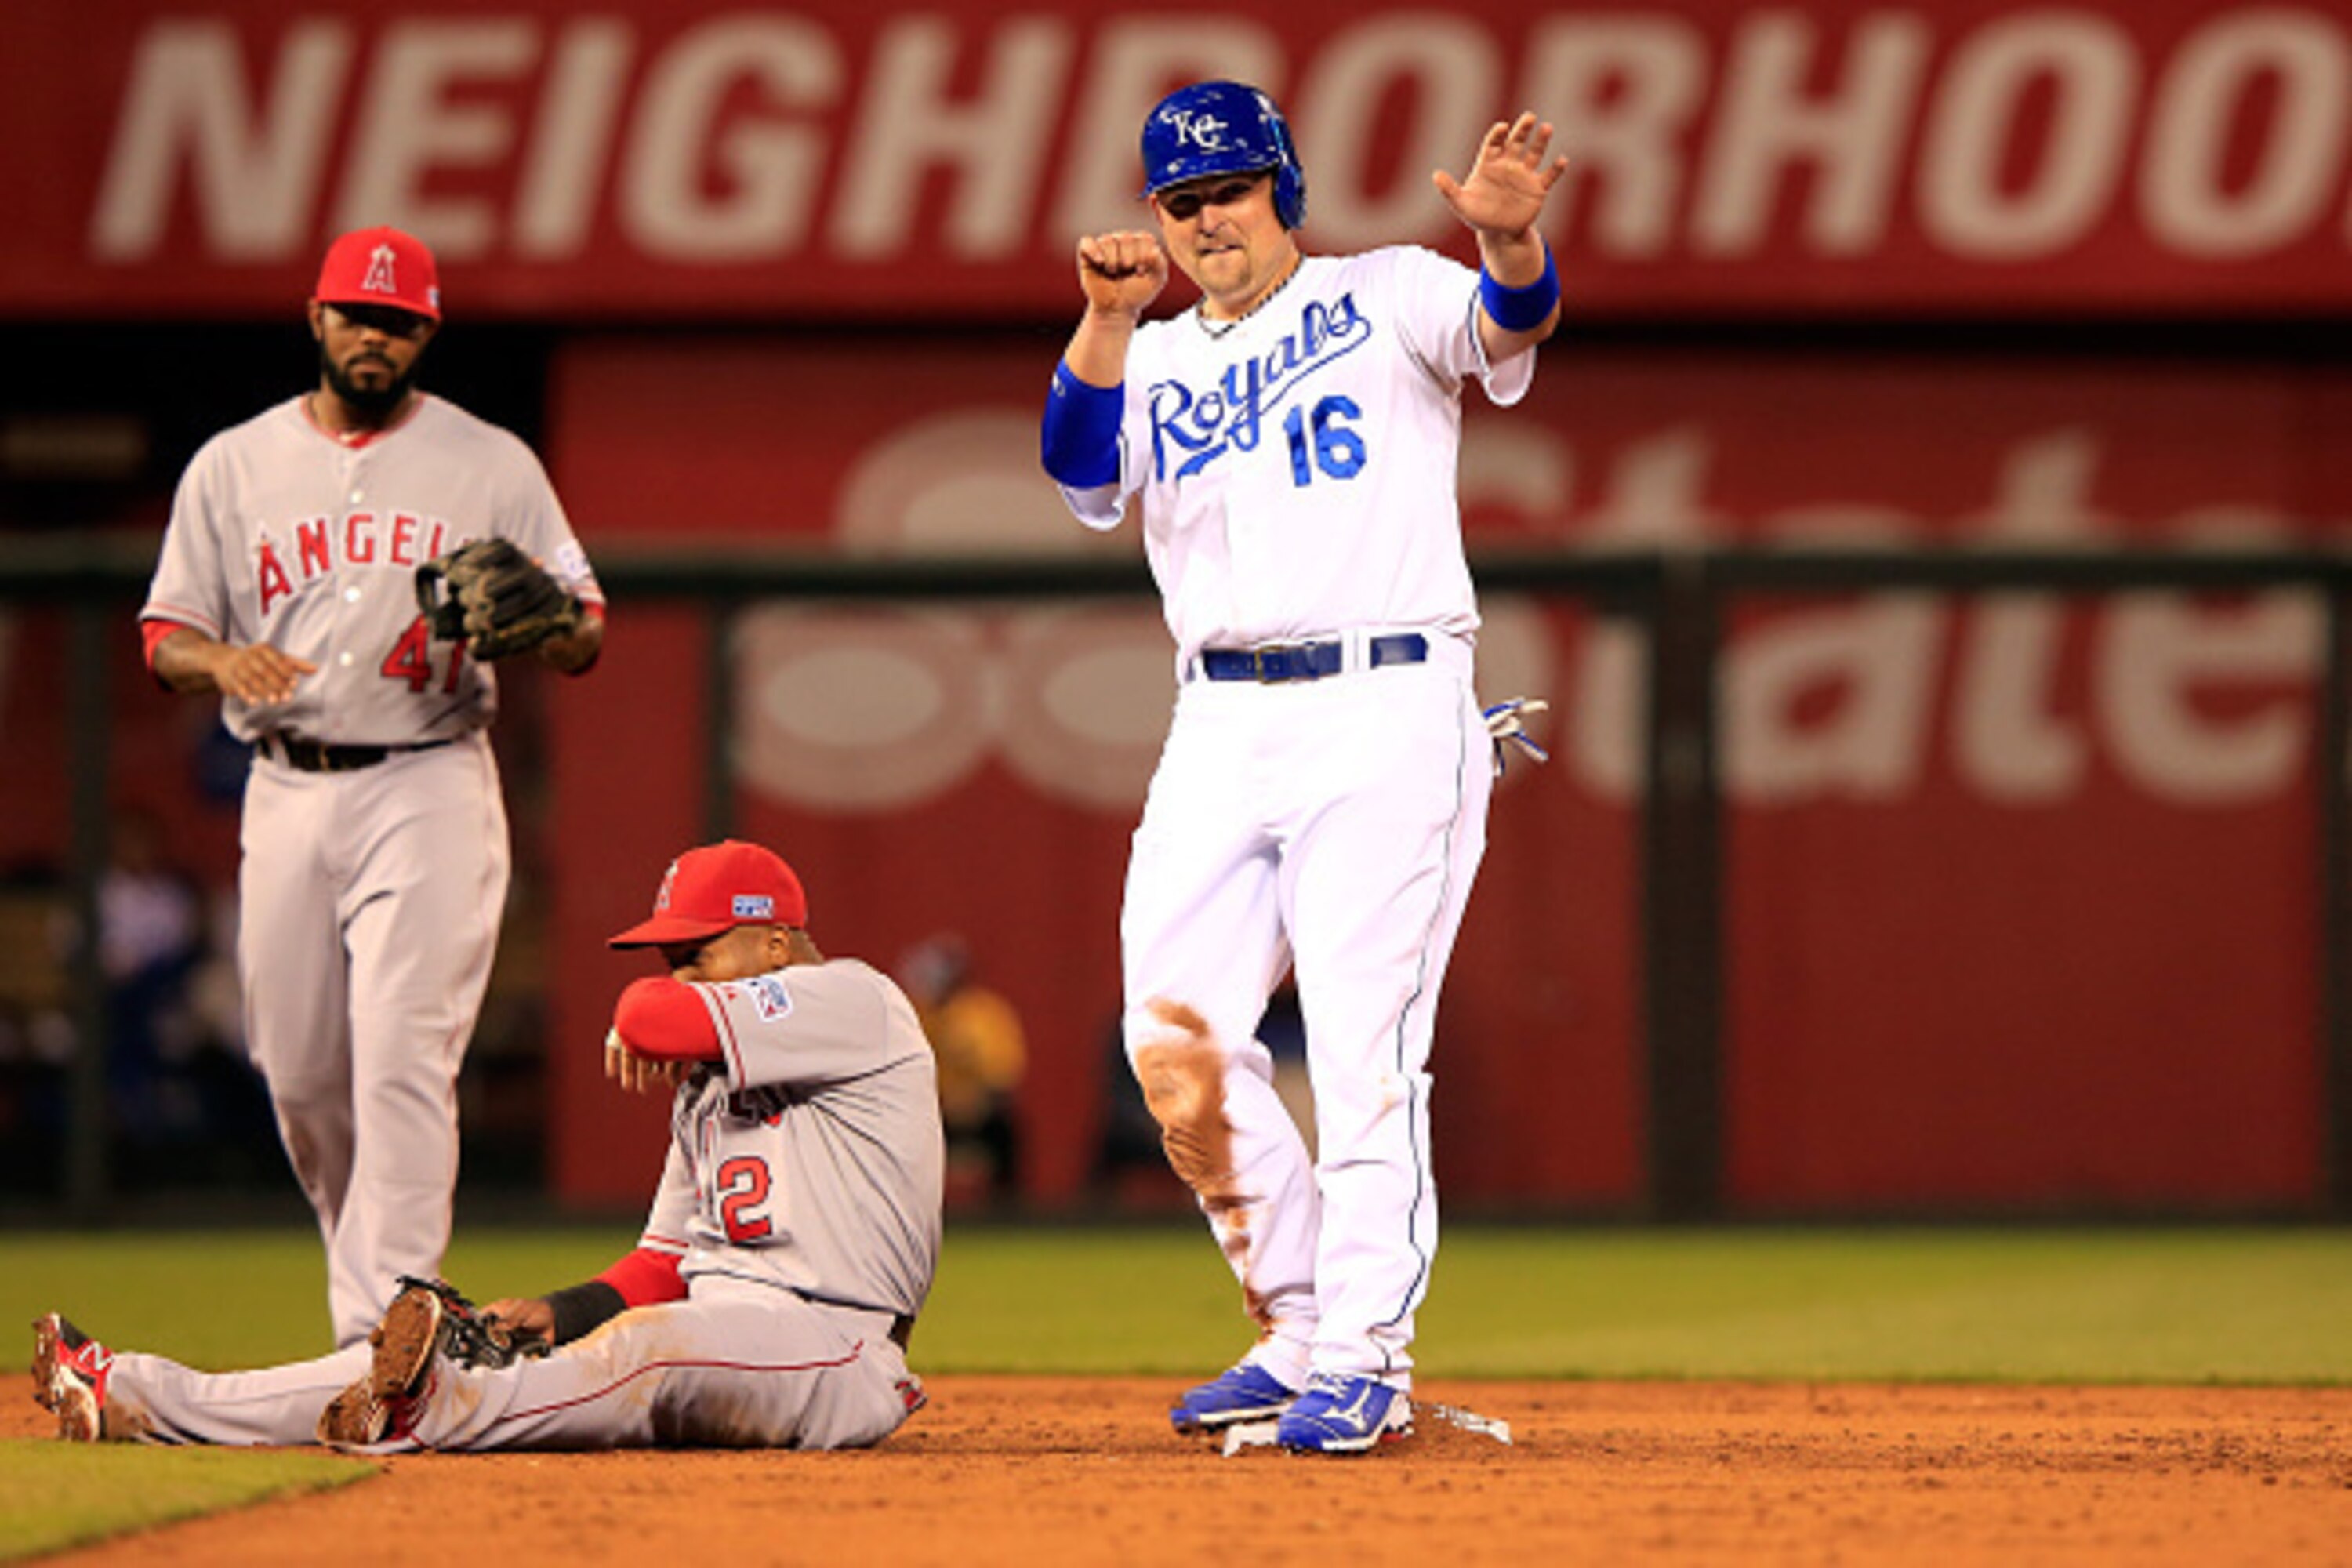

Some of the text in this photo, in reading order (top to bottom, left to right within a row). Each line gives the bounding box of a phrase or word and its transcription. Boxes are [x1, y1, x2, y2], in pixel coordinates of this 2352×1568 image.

[361, 243, 396, 293] A
[1148, 291, 1372, 482] Royals
[1283, 394, 1367, 488] 16
[257, 513, 469, 617] ANGEL
[380, 612, 468, 694] 41
[717, 1156, 773, 1245] 2
